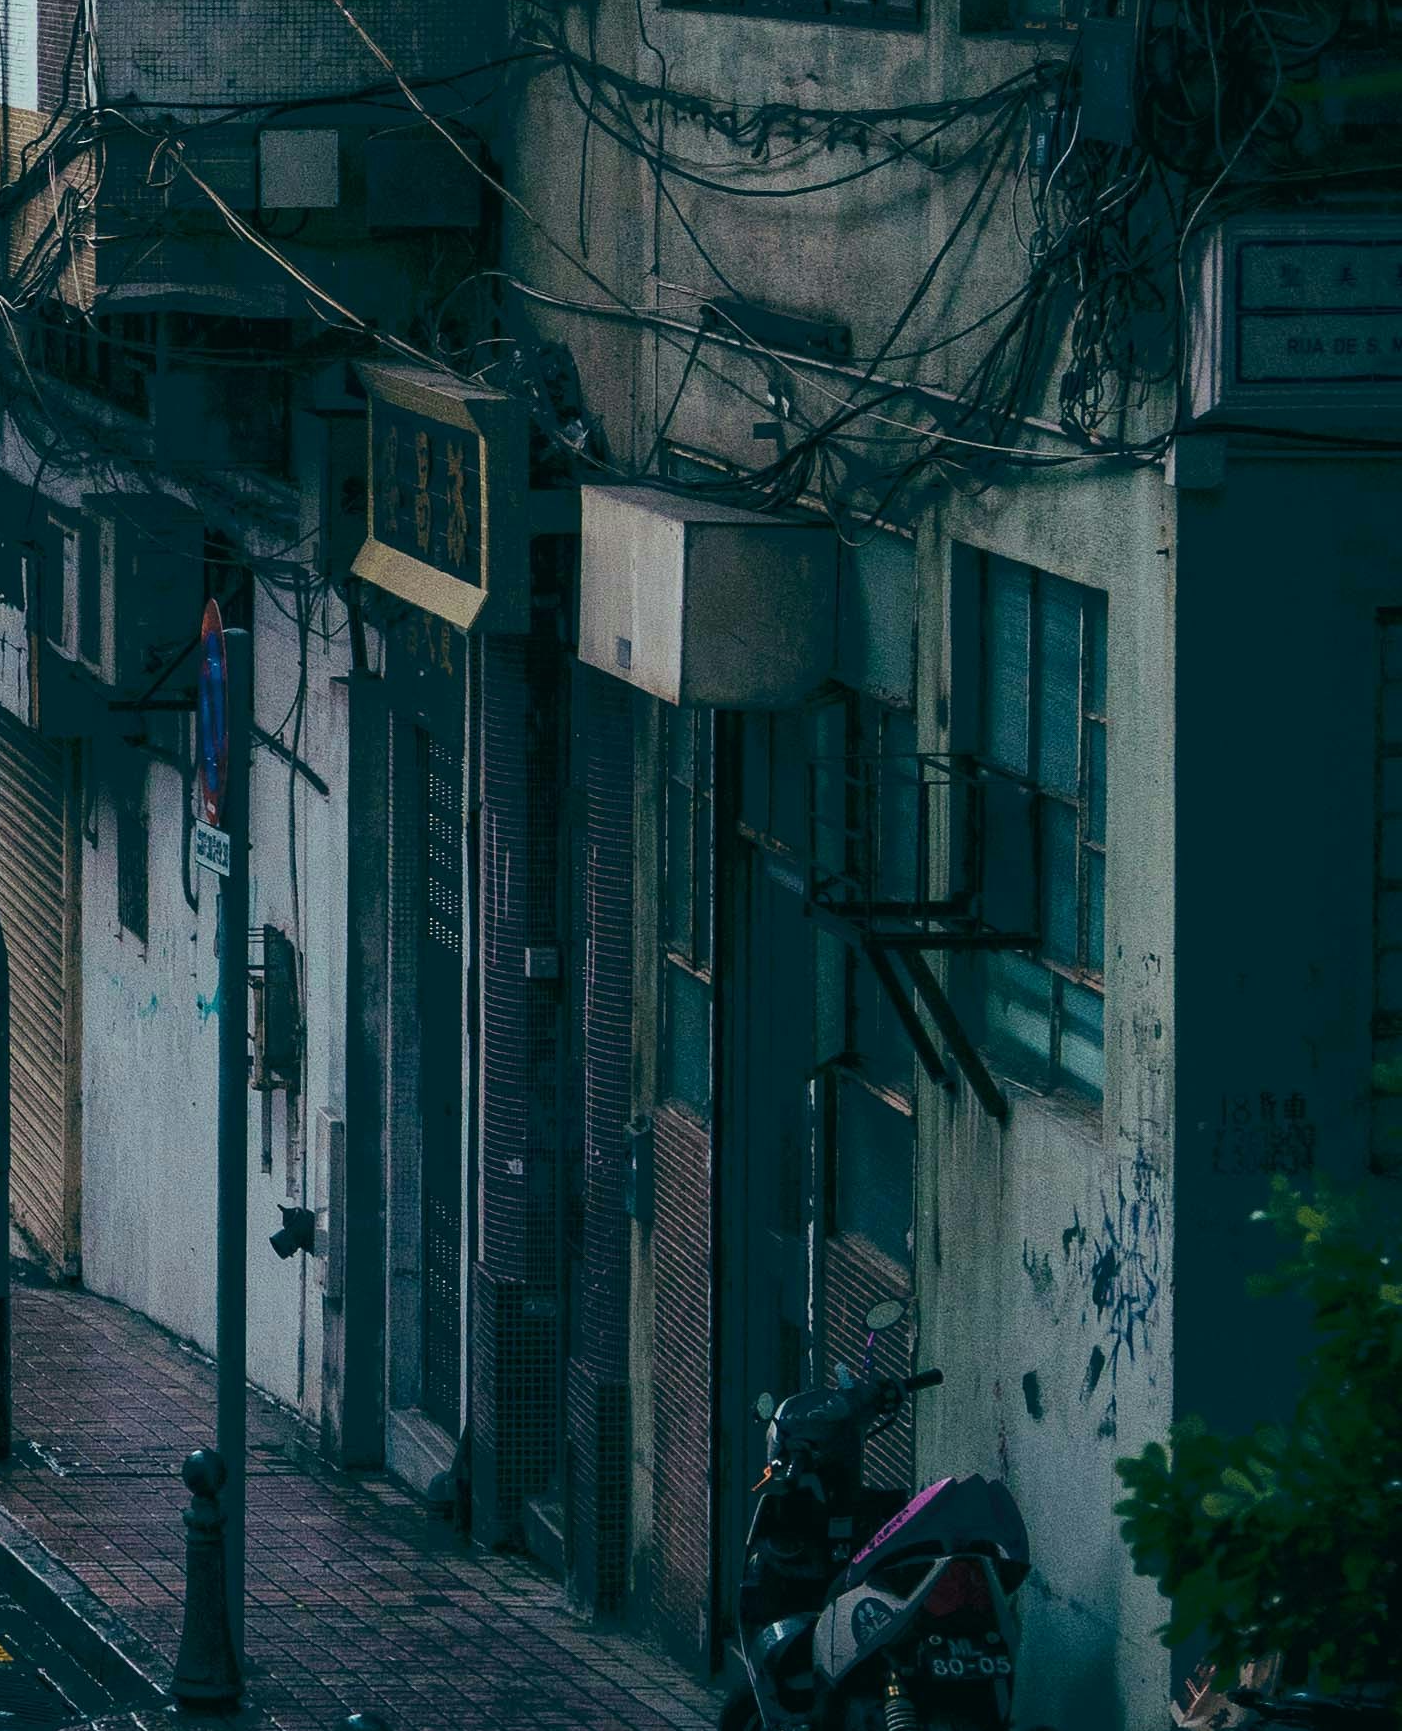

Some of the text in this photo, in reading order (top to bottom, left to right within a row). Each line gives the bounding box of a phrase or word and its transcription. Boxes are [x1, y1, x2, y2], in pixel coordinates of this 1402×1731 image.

[1287, 338, 1325, 354] RUA
[1334, 338, 1356, 353] DE
[933, 1657, 1011, 1675] 80-05
